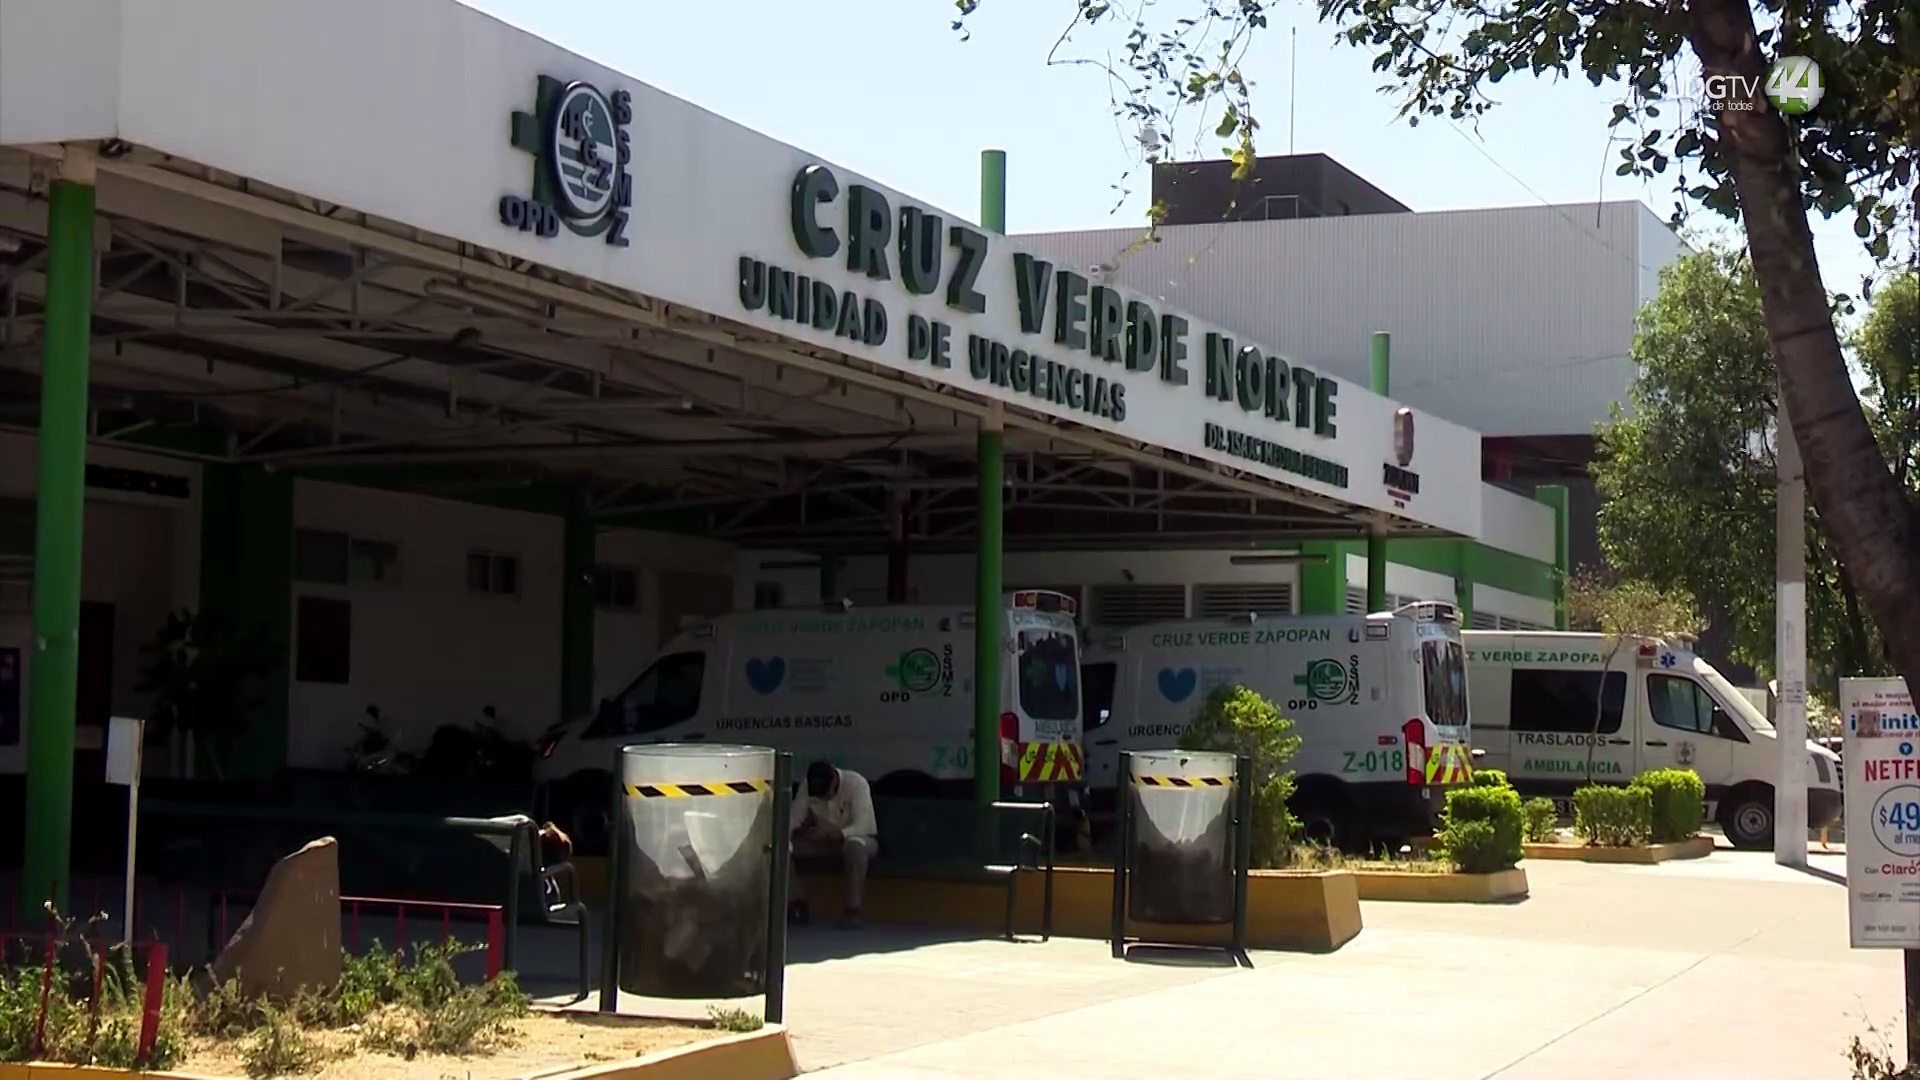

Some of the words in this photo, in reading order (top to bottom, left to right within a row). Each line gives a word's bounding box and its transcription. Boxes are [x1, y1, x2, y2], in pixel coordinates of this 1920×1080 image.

[499, 195, 559, 238] OPD
[791, 163, 989, 314] CRUZ
[1013, 252, 1189, 386] VERDE
[1205, 332, 1338, 439] NORTE
[739, 256, 888, 347] UNIDAD
[908, 314, 951, 369] DE
[969, 334, 1127, 423] URGENCIAS
[1152, 632, 1194, 648] CRUZ
[1198, 631, 1251, 647] VERDE
[1255, 628, 1331, 645] ZAPOPAN
[1481, 651, 1534, 664] VERDE
[880, 692, 910, 702] OPD
[1288, 699, 1318, 711] OPD
[716, 716, 790, 730] URGENCIAS
[794, 714, 853, 729] BASICAS
[1517, 732, 1607, 748] TRASLADOS
[1343, 750, 1403, 774] Z-018
[1523, 758, 1623, 774] AMBULANCIA
